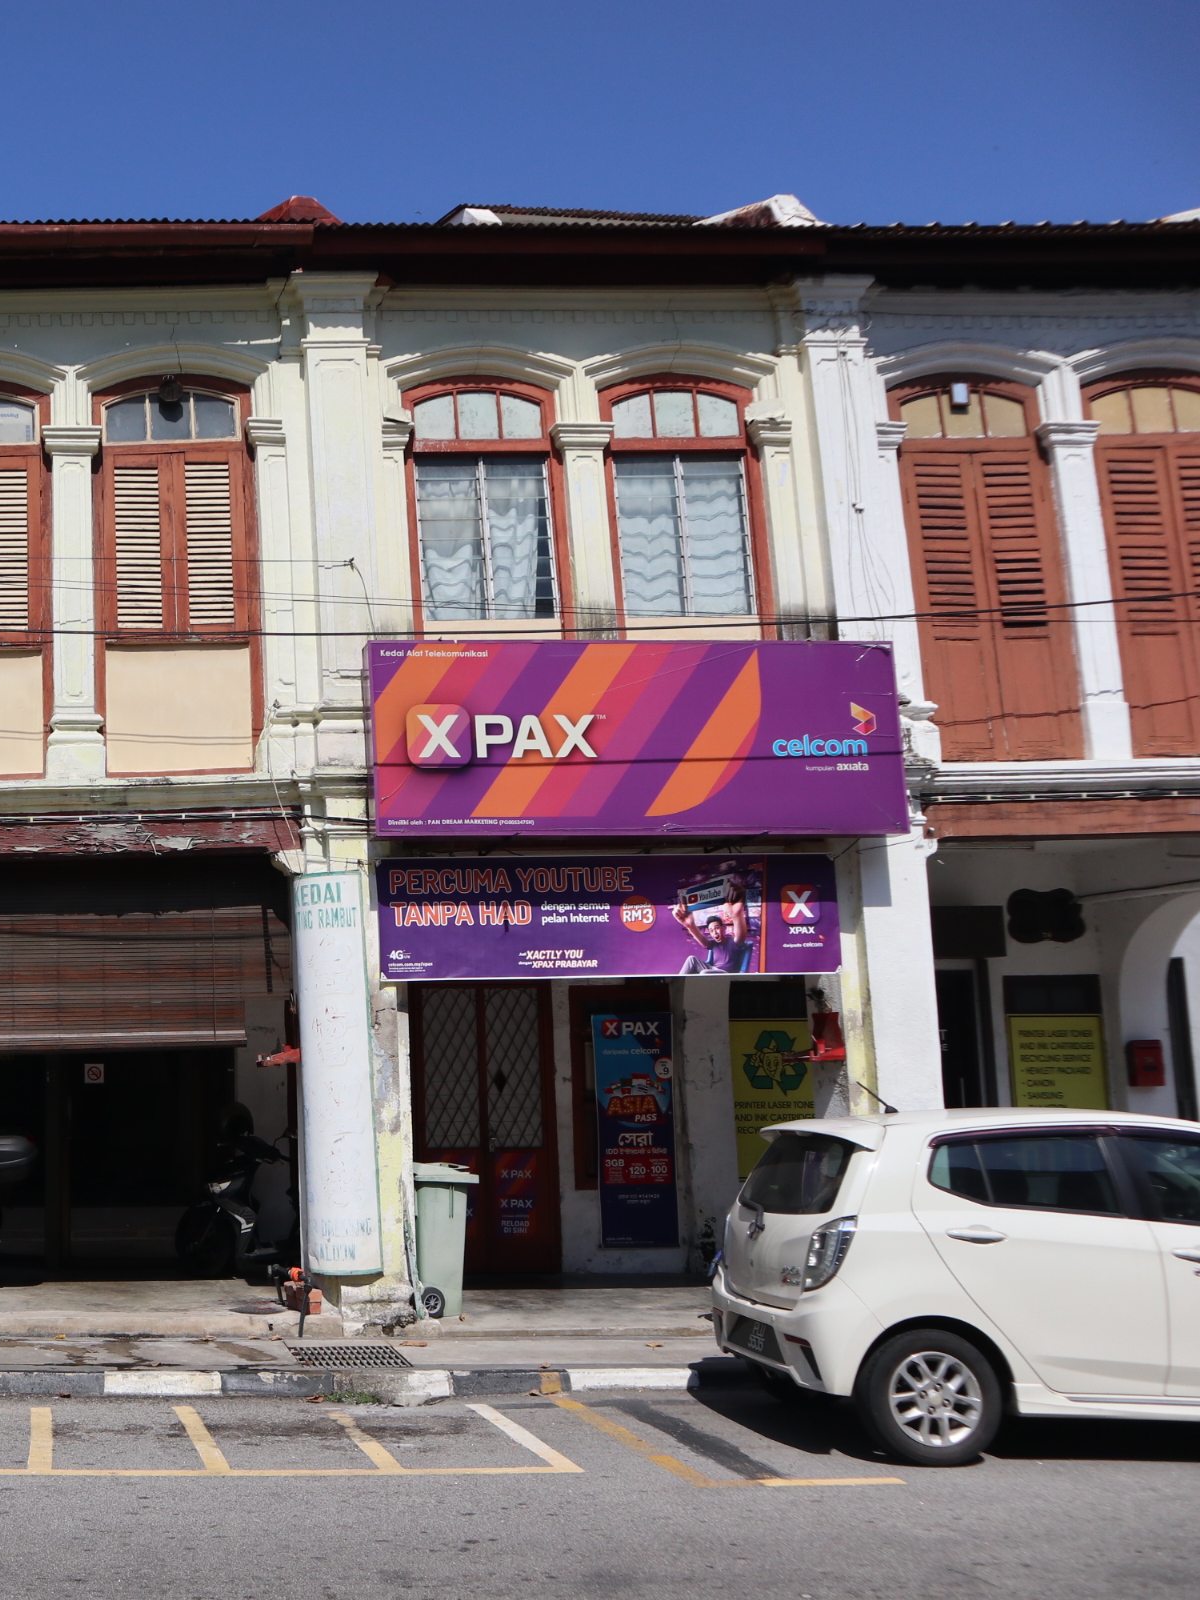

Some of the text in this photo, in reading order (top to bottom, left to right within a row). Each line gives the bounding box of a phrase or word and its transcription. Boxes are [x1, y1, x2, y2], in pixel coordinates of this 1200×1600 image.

[380, 647, 489, 659] Kedai Alat Telekomunikasi
[772, 733, 869, 757] celcom
[836, 760, 870, 771] axiata
[441, 818, 463, 826] DREAM
[464, 818, 499, 826] MARKETING
[388, 866, 635, 895] PERCUMA YOUTUBE
[699, 889, 722, 901] YouTube
[540, 901, 611, 913] dengan semua
[318, 906, 357, 929] RAMBUT
[389, 900, 533, 928] TANPA HAD
[622, 908, 654, 924] RM3
[541, 912, 610, 926] pelan Internet
[788, 926, 816, 935] XPAX
[389, 950, 404, 960] 4G
[525, 949, 563, 960] XACTLY
[563, 949, 584, 960] YOU
[531, 960, 555, 969] XPAX
[554, 959, 599, 969] PRABAYAR
[1018, 1029, 1094, 1038] PRINTER LASER TONER
[1019, 1042, 1036, 1050] AND
[1050, 1042, 1095, 1050] CARTRIDGES
[630, 1047, 661, 1055] celcom
[1019, 1054, 1092, 1062] RECYCLING SERVICE
[1025, 1066, 1092, 1075] HEWLETT PACKARD
[1026, 1079, 1056, 1088] CANON
[1026, 1091, 1064, 1100] SAMSUNG
[606, 1095, 659, 1116] ASIA
[734, 1101, 766, 1109] PRINTER
[767, 1101, 792, 1109] LASER
[634, 1113, 658, 1122] PASS
[734, 1113, 753, 1122] AND
[754, 1113, 768, 1122] INK
[618, 1130, 654, 1147] সেরা
[605, 1158, 625, 1167] 3GB
[628, 1166, 647, 1175] 120
[650, 1165, 668, 1174] 100
